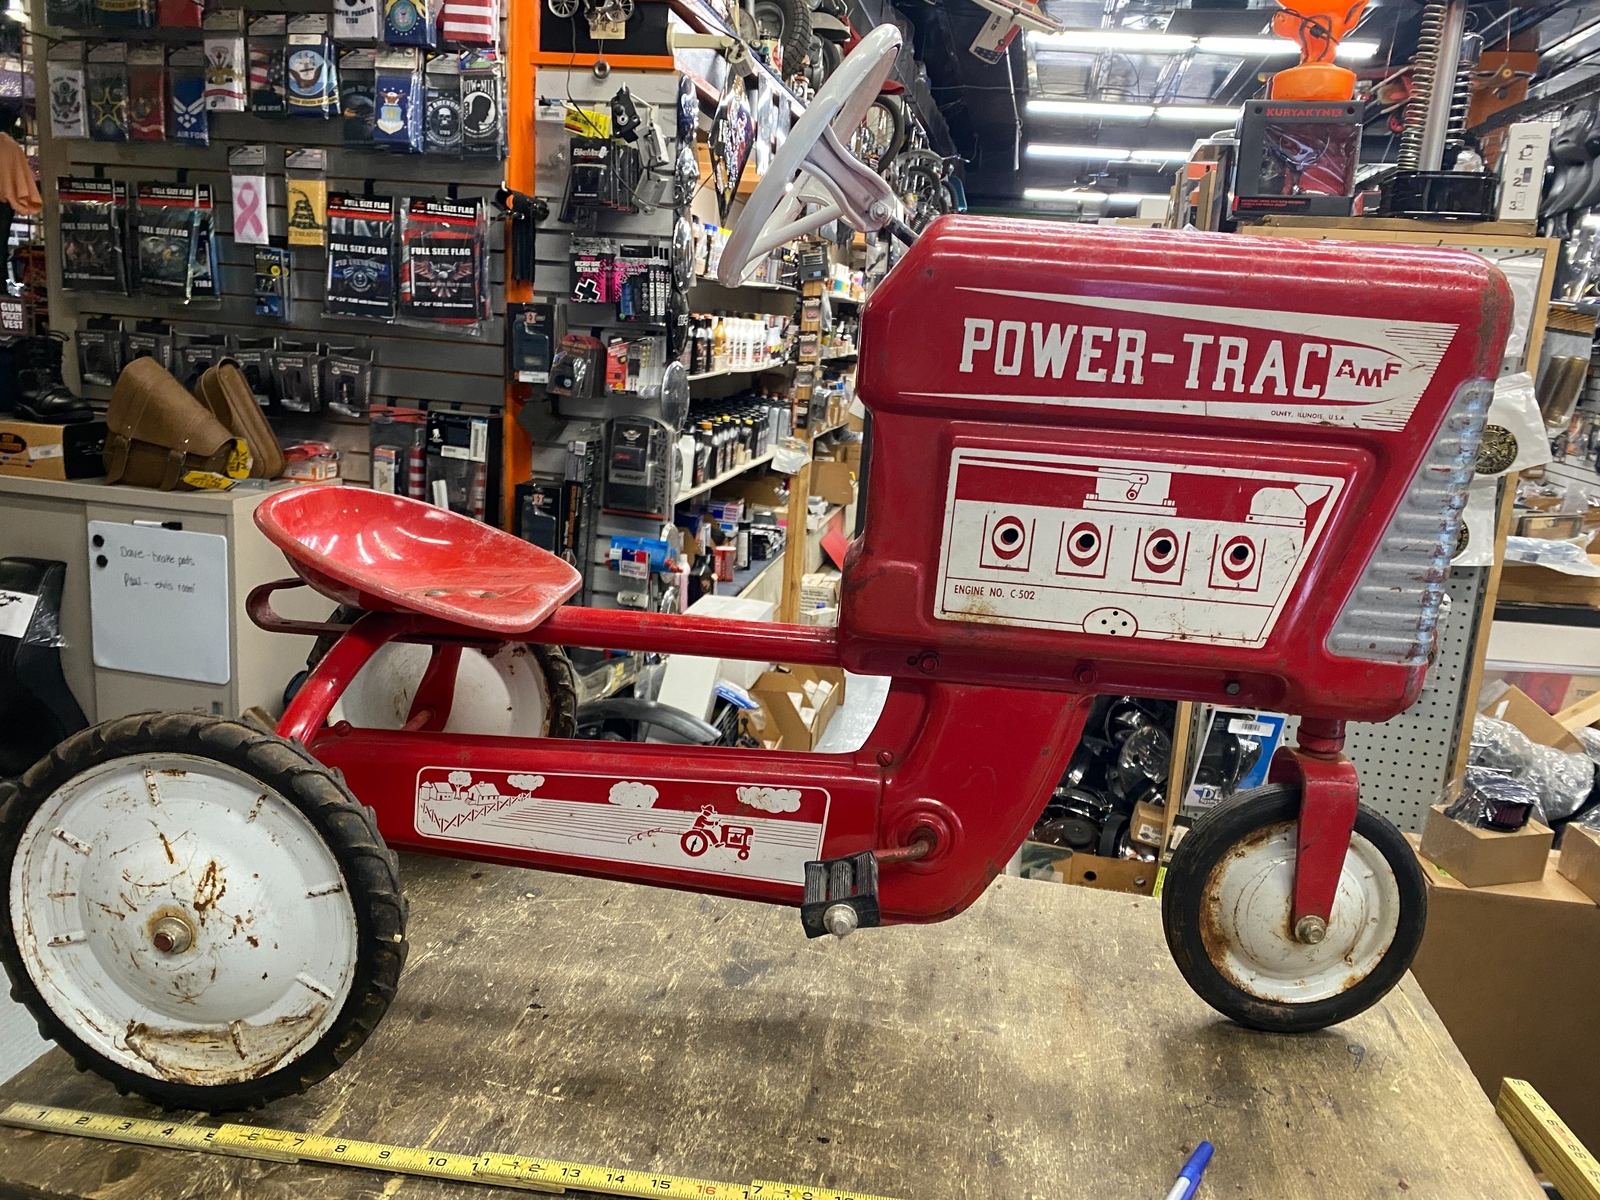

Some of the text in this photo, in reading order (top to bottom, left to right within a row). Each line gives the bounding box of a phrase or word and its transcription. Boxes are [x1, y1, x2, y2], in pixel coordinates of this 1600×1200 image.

[1512, 177, 1522, 187] 2
[344, 199, 390, 209] FULL SIZE FLAG
[427, 203, 474, 214] FULL SIZE FLAG
[1509, 200, 1517, 211] 3
[330, 243, 388, 255] FULL SIZE FLAG
[411, 247, 471, 256] FULL SIZE FLAG
[1, 302, 22, 312] GUN
[3, 320, 23, 329] VEST
[959, 317, 1328, 398] POWER-TRAC
[1335, 359, 1402, 388] AMF
[1270, 410, 1294, 418] OLNEY,
[1297, 412, 1325, 420] ILLINOIS,
[954, 584, 1036, 600] ENGINE NO. C-502
[37, 1111, 47, 1119] 1
[75, 1116, 89, 1125] 2
[118, 1121, 132, 1131] 3
[161, 1127, 175, 1136] 4
[294, 1138, 305, 1149] 7
[335, 1144, 347, 1153] 8
[378, 1150, 391, 1160] 9
[427, 1156, 448, 1168] 10
[561, 1167, 581, 1178] 13
[606, 1173, 626, 1184] 14
[650, 1179, 672, 1190] 15
[696, 1185, 716, 1195] 16
